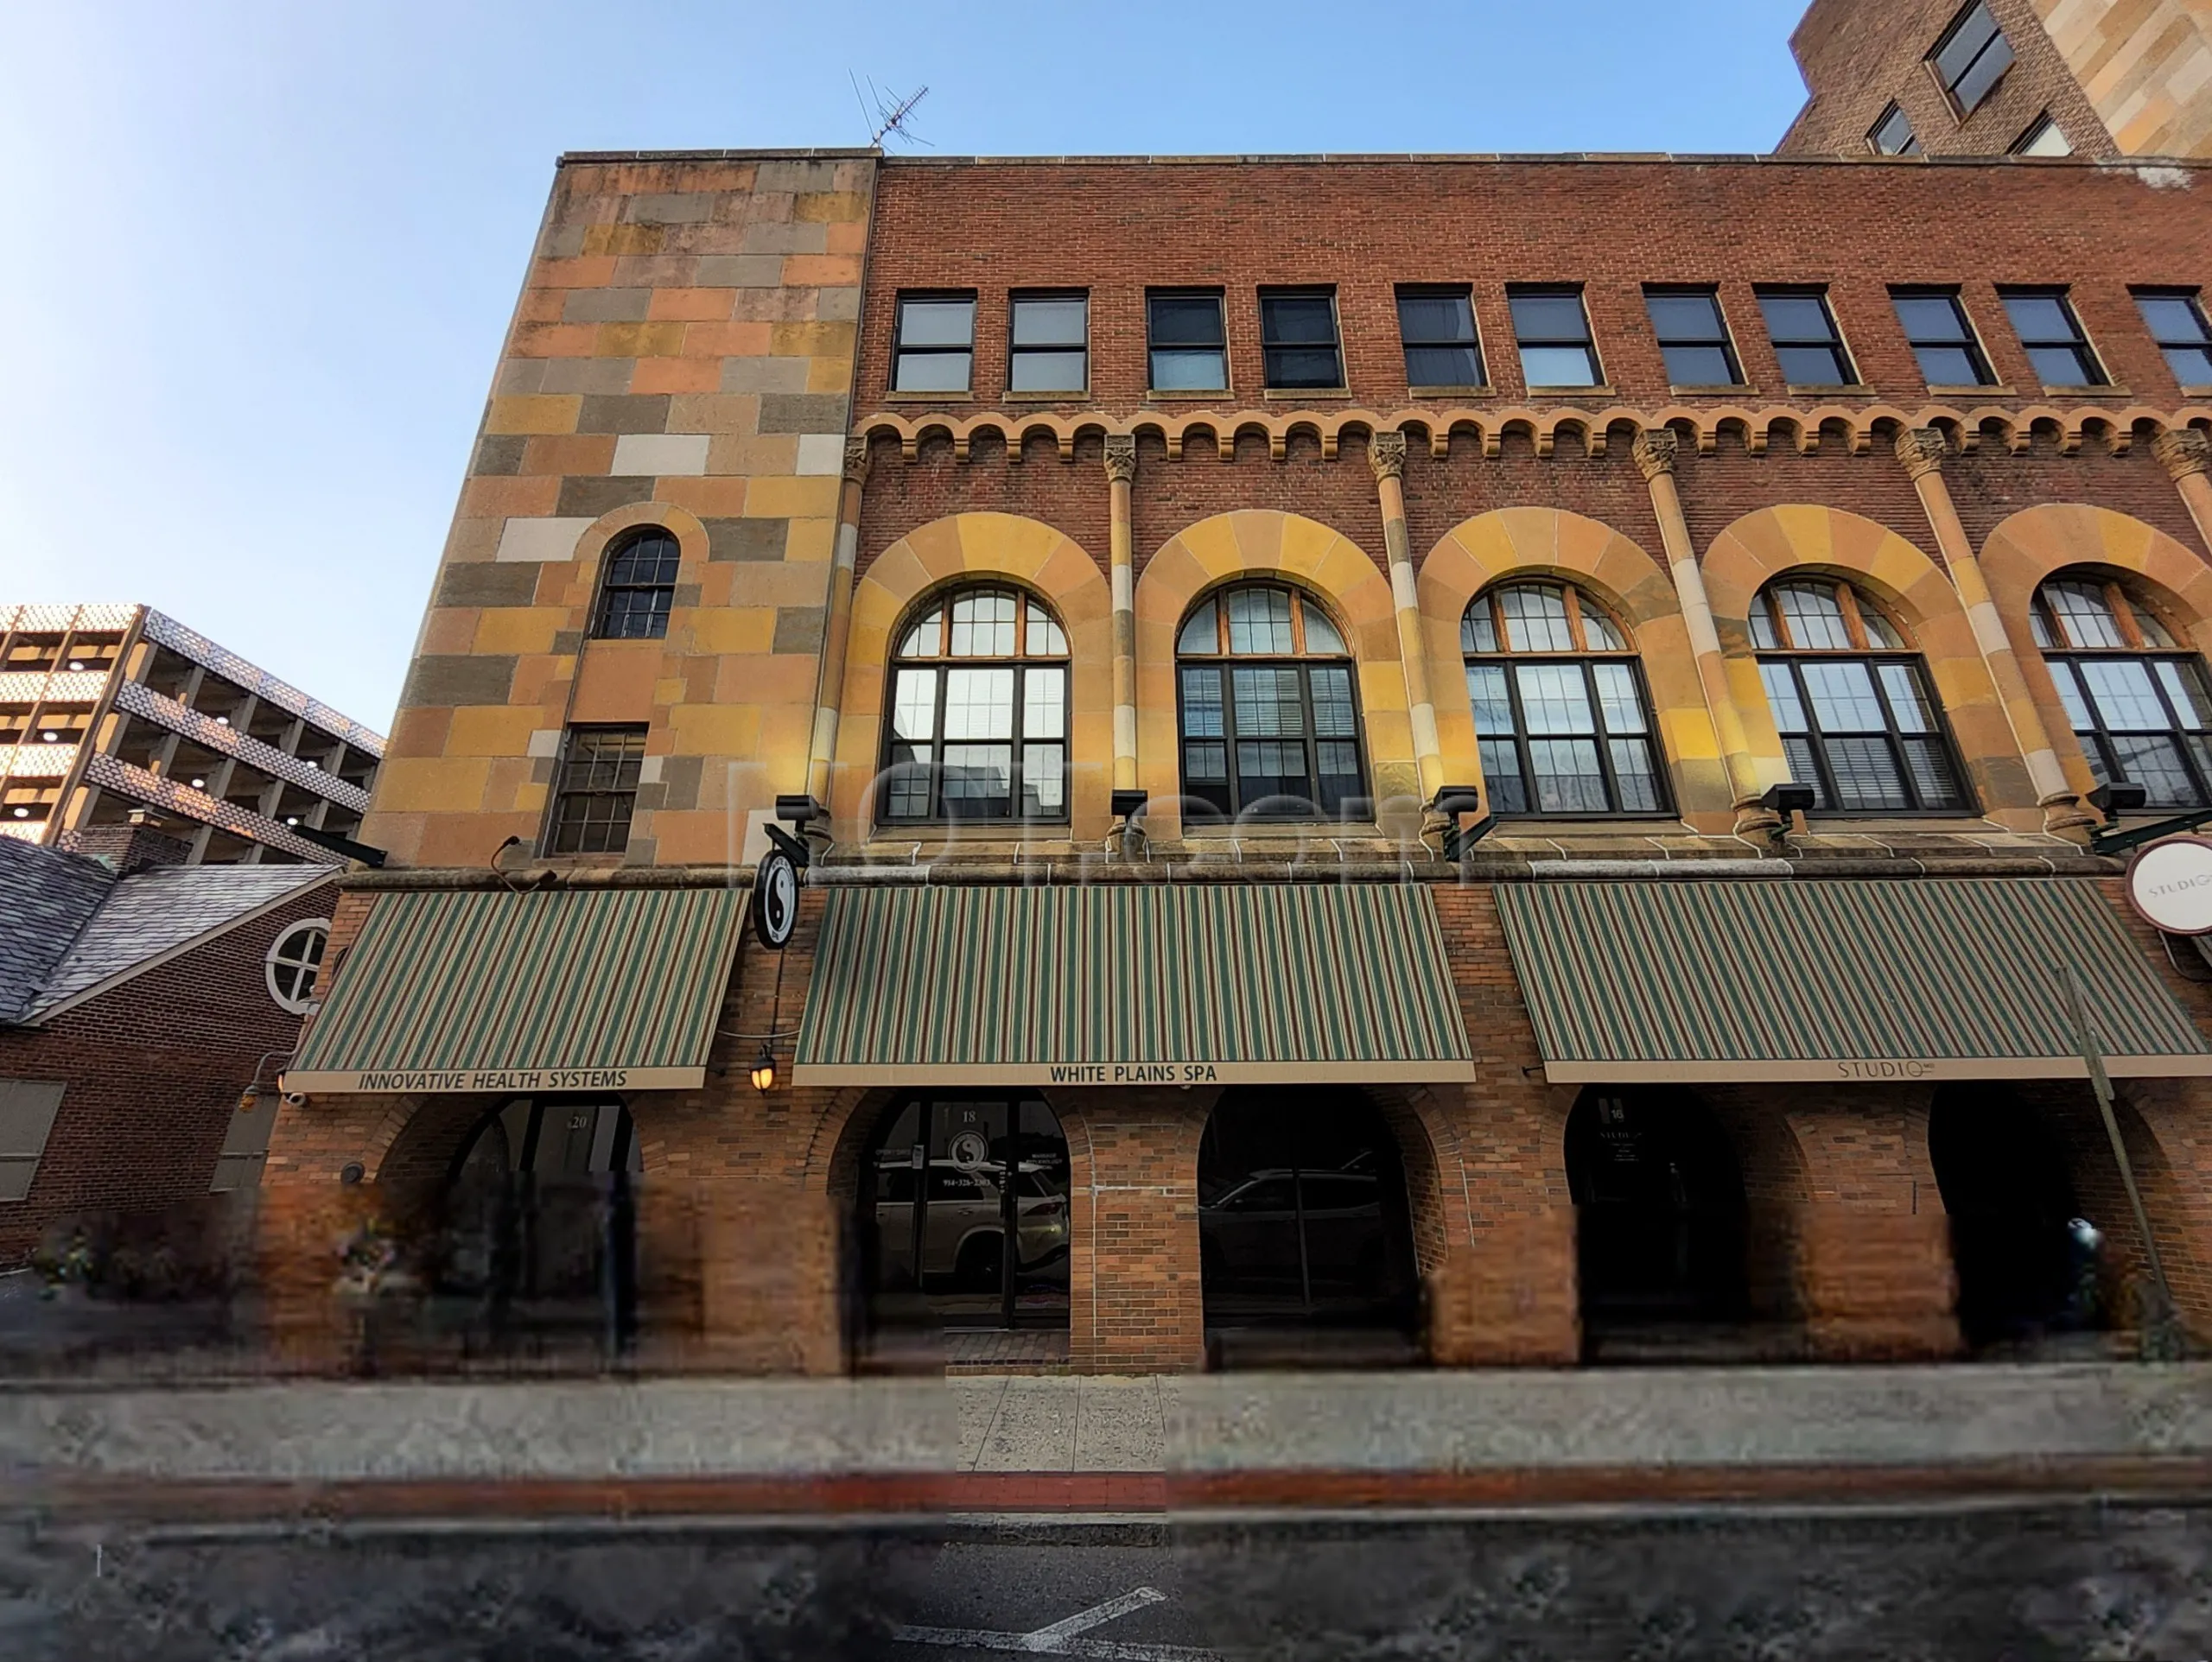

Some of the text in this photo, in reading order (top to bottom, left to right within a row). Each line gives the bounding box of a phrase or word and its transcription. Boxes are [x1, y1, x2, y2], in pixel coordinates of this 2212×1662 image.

[1050, 1064, 1217, 1082] WHITE PLAINS SPA
[1837, 1060, 1924, 1079] STUDIO
[358, 1070, 627, 1090] INNOVATIVE HEALTH SYSTEMS
[571, 1116, 588, 1129] 20
[963, 1110, 976, 1123] 18
